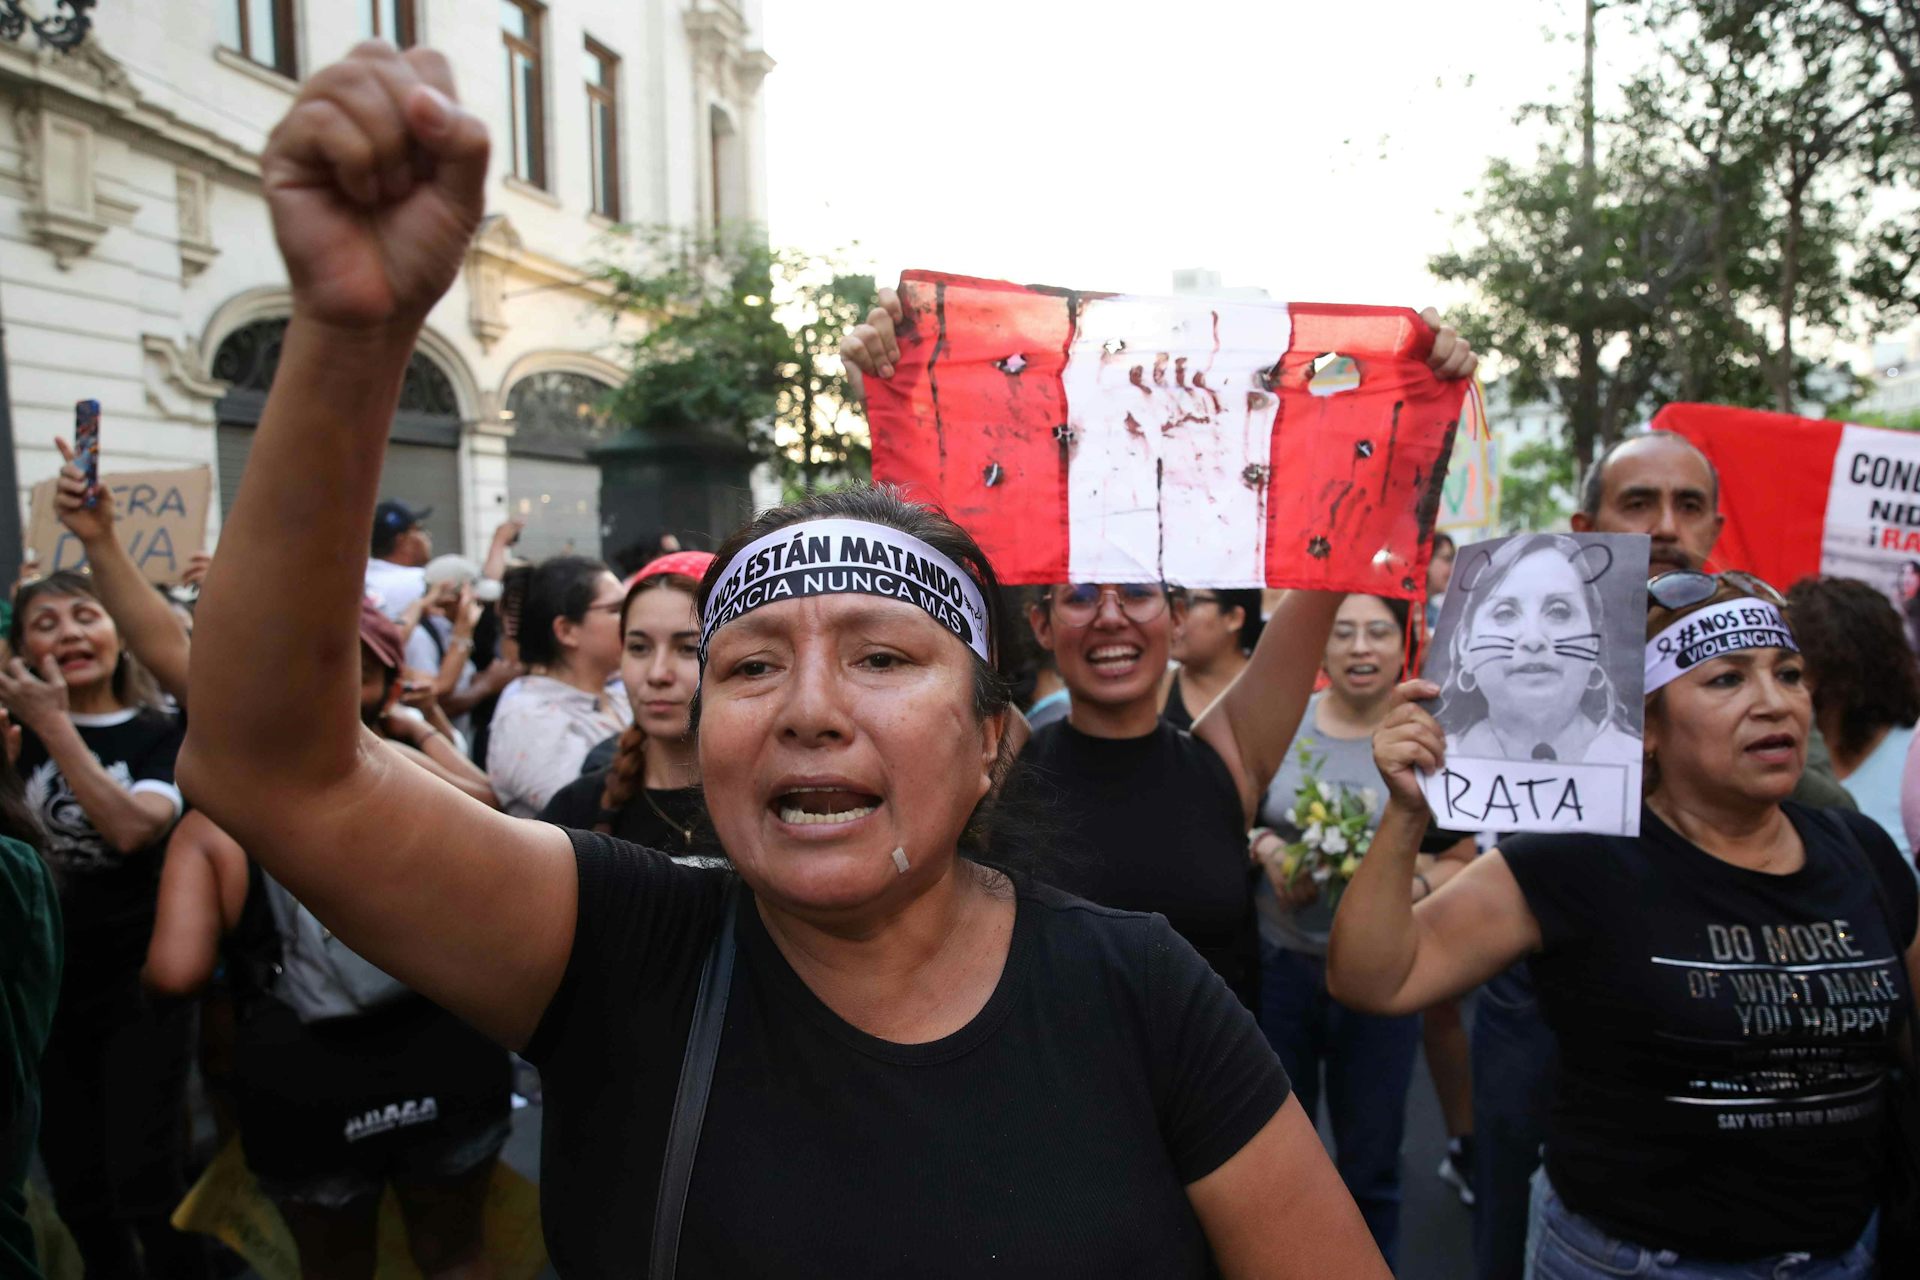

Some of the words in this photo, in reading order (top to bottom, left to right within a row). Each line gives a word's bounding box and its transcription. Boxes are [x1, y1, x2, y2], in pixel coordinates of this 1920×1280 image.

[54, 526, 176, 573] DA
[744, 532, 831, 584] ESTÁN
[840, 535, 963, 608] MATANDO
[803, 571, 915, 604] NUNCA
[919, 591, 962, 634] MÁS
[1676, 610, 1739, 648] #NOS
[1743, 607, 1788, 627] ESTÁ
[1686, 630, 1783, 662] VIOLENCIA
[1442, 768, 1583, 823] RATA
[1707, 924, 1755, 962] DO
[1761, 919, 1864, 963] MORE
[1687, 970, 1721, 998] OF
[1729, 973, 1812, 1005] WHAT
[1735, 1004, 1793, 1036] YOU
[1800, 1006, 1890, 1036] HAPPY
[1718, 1113, 1746, 1130] SAY
[1748, 1112, 1774, 1129] YES
[1776, 1111, 1793, 1127] TO
